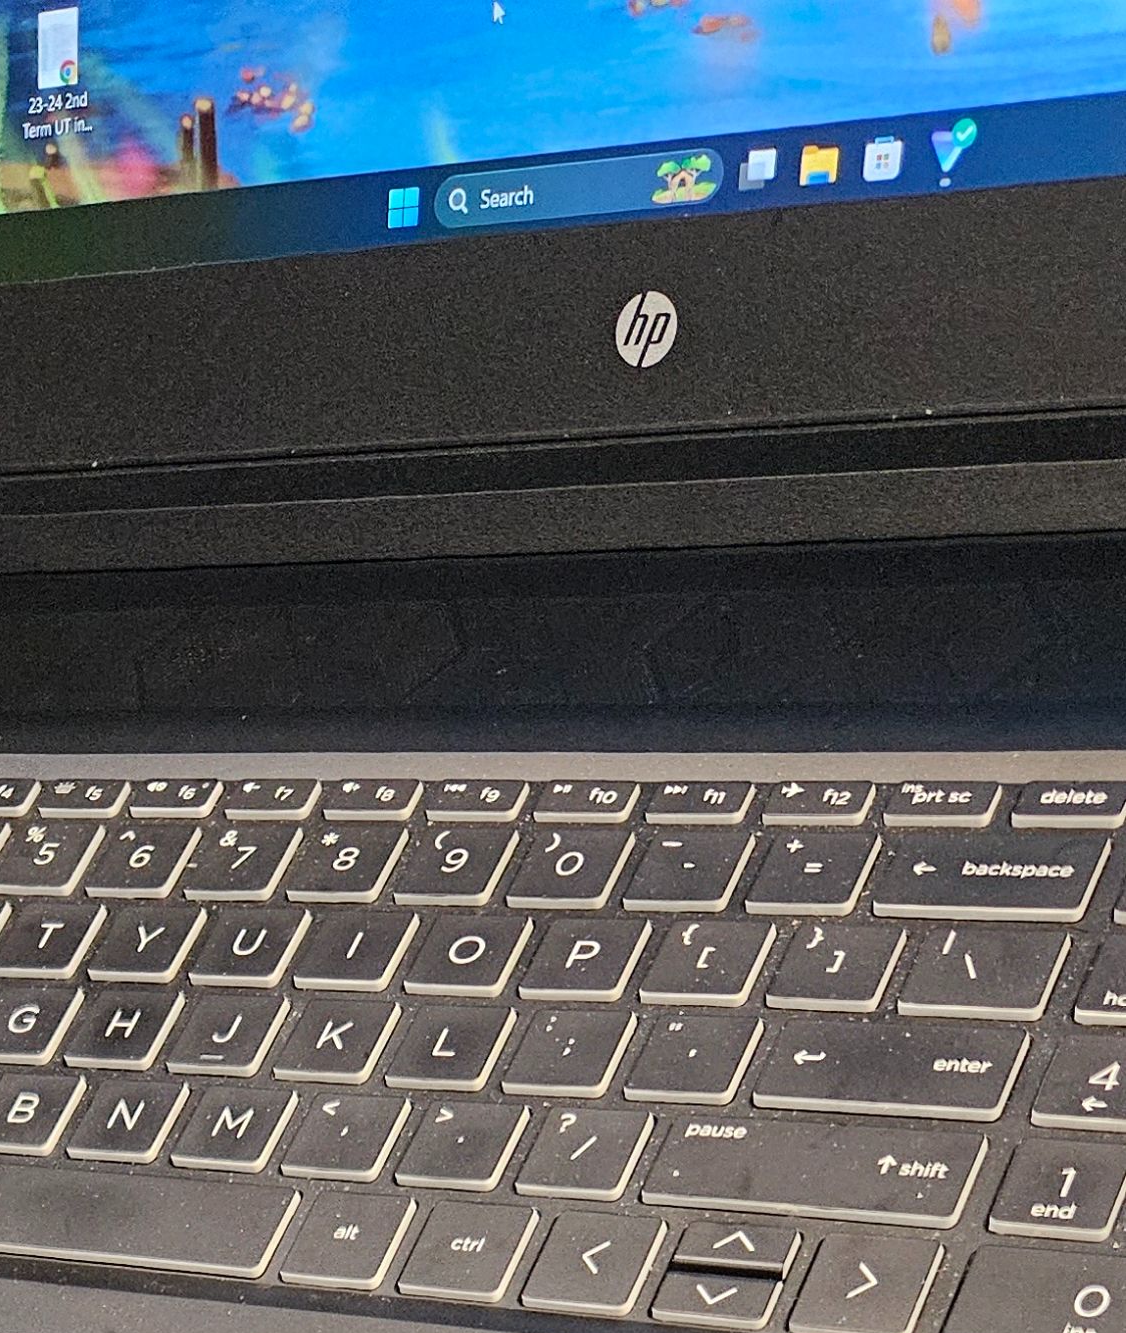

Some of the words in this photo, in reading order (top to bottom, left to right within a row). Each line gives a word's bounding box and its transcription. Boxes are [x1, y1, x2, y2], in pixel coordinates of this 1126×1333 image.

[27, 96, 63, 114] 23-24
[64, 90, 88, 110] 2nd
[22, 122, 52, 139] Term
[54, 117, 72, 137] UT
[480, 184, 534, 209] Search
[84, 785, 104, 801] f5
[177, 784, 197, 800] f6
[274, 785, 294, 801] f7
[375, 786, 396, 802] f8
[479, 786, 501, 803] f9
[588, 787, 618, 804] f10
[703, 788, 727, 805] f11
[822, 788, 852, 806] f12
[909, 788, 946, 805] prt
[947, 791, 973, 803] sc
[1040, 788, 1108, 805] delete
[33, 842, 60, 865] 5
[129, 844, 155, 868] 6
[231, 846, 257, 870] 7
[332, 846, 361, 871] 8
[440, 848, 469, 873] 9
[961, 860, 1075, 879] backspace
[38, 922, 65, 949] T
[137, 925, 166, 953] Y
[232, 928, 268, 956] U
[448, 935, 486, 965] O
[565, 940, 601, 971] P
[7, 1004, 41, 1034] G
[104, 1008, 142, 1038] H
[212, 1014, 243, 1043] J
[316, 1020, 354, 1050] K
[431, 1027, 456, 1057] L
[933, 1057, 993, 1074] enter
[1088, 1061, 1121, 1091] 4
[6, 1092, 40, 1124] B
[106, 1098, 145, 1131] N
[211, 1106, 255, 1139] M
[684, 1123, 748, 1139] pause
[898, 1160, 950, 1179] shift
[1059, 1167, 1077, 1198] 1
[1030, 1202, 1078, 1220] end
[333, 1224, 360, 1241] alt
[450, 1236, 485, 1253] ctrl
